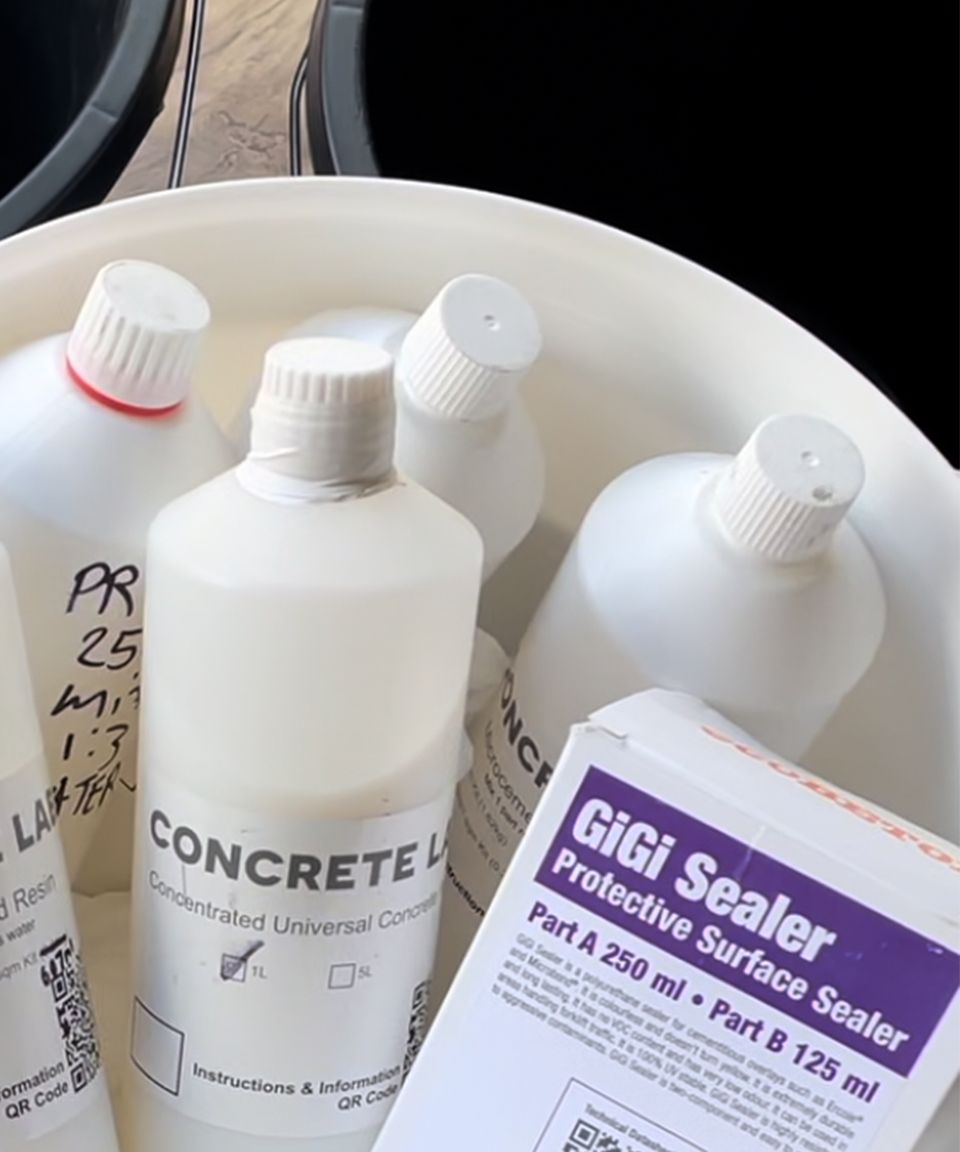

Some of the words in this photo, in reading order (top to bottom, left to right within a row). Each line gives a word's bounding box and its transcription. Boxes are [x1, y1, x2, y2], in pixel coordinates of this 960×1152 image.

[65, 562, 139, 617] PR
[63, 724, 129, 772] 1:3
[150, 810, 418, 891] CONCRETE
[572, 798, 678, 881] GiGi
[674, 850, 838, 963] Sealer
[12, 873, 57, 914] Resin
[149, 869, 265, 932] Concentrated
[273, 914, 372, 937] Universal
[251, 966, 268, 979] 1L
[551, 847, 694, 942] Protective
[696, 923, 809, 1001] Surface
[812, 986, 910, 1054] Sealer
[508, 945, 528, 962] and
[644, 1020, 664, 1037] and
[527, 901, 582, 945] Part
[578, 930, 599, 957] A
[600, 941, 649, 982] 250
[650, 968, 688, 1003] ml
[709, 997, 764, 1044] Part
[766, 1027, 790, 1054] B
[792, 1041, 841, 1083] 125
[841, 1070, 881, 1104] ml
[519, 968, 541, 987] long
[609, 1017, 631, 1035] VOC
[629, 1028, 666, 1054] content
[664, 1047, 685, 1064] and
[683, 1057, 703, 1074] has
[701, 1069, 724, 1087] very
[723, 1079, 743, 1095] low
[779, 1110, 798, 1126] can
[520, 985, 561, 1014] handling
[635, 1048, 664, 1069] 100%
[768, 1120, 800, 1144] highly
[5, 1096, 32, 1120] QR
[35, 1082, 69, 1107] Code
[193, 1062, 295, 1095] Instructions
[301, 1082, 314, 1095] &
[319, 1064, 401, 1095] Information
[337, 1094, 362, 1111] QR
[365, 1084, 399, 1105] Code
[739, 1120, 759, 1137] and
[757, 1131, 782, 1151] easy
